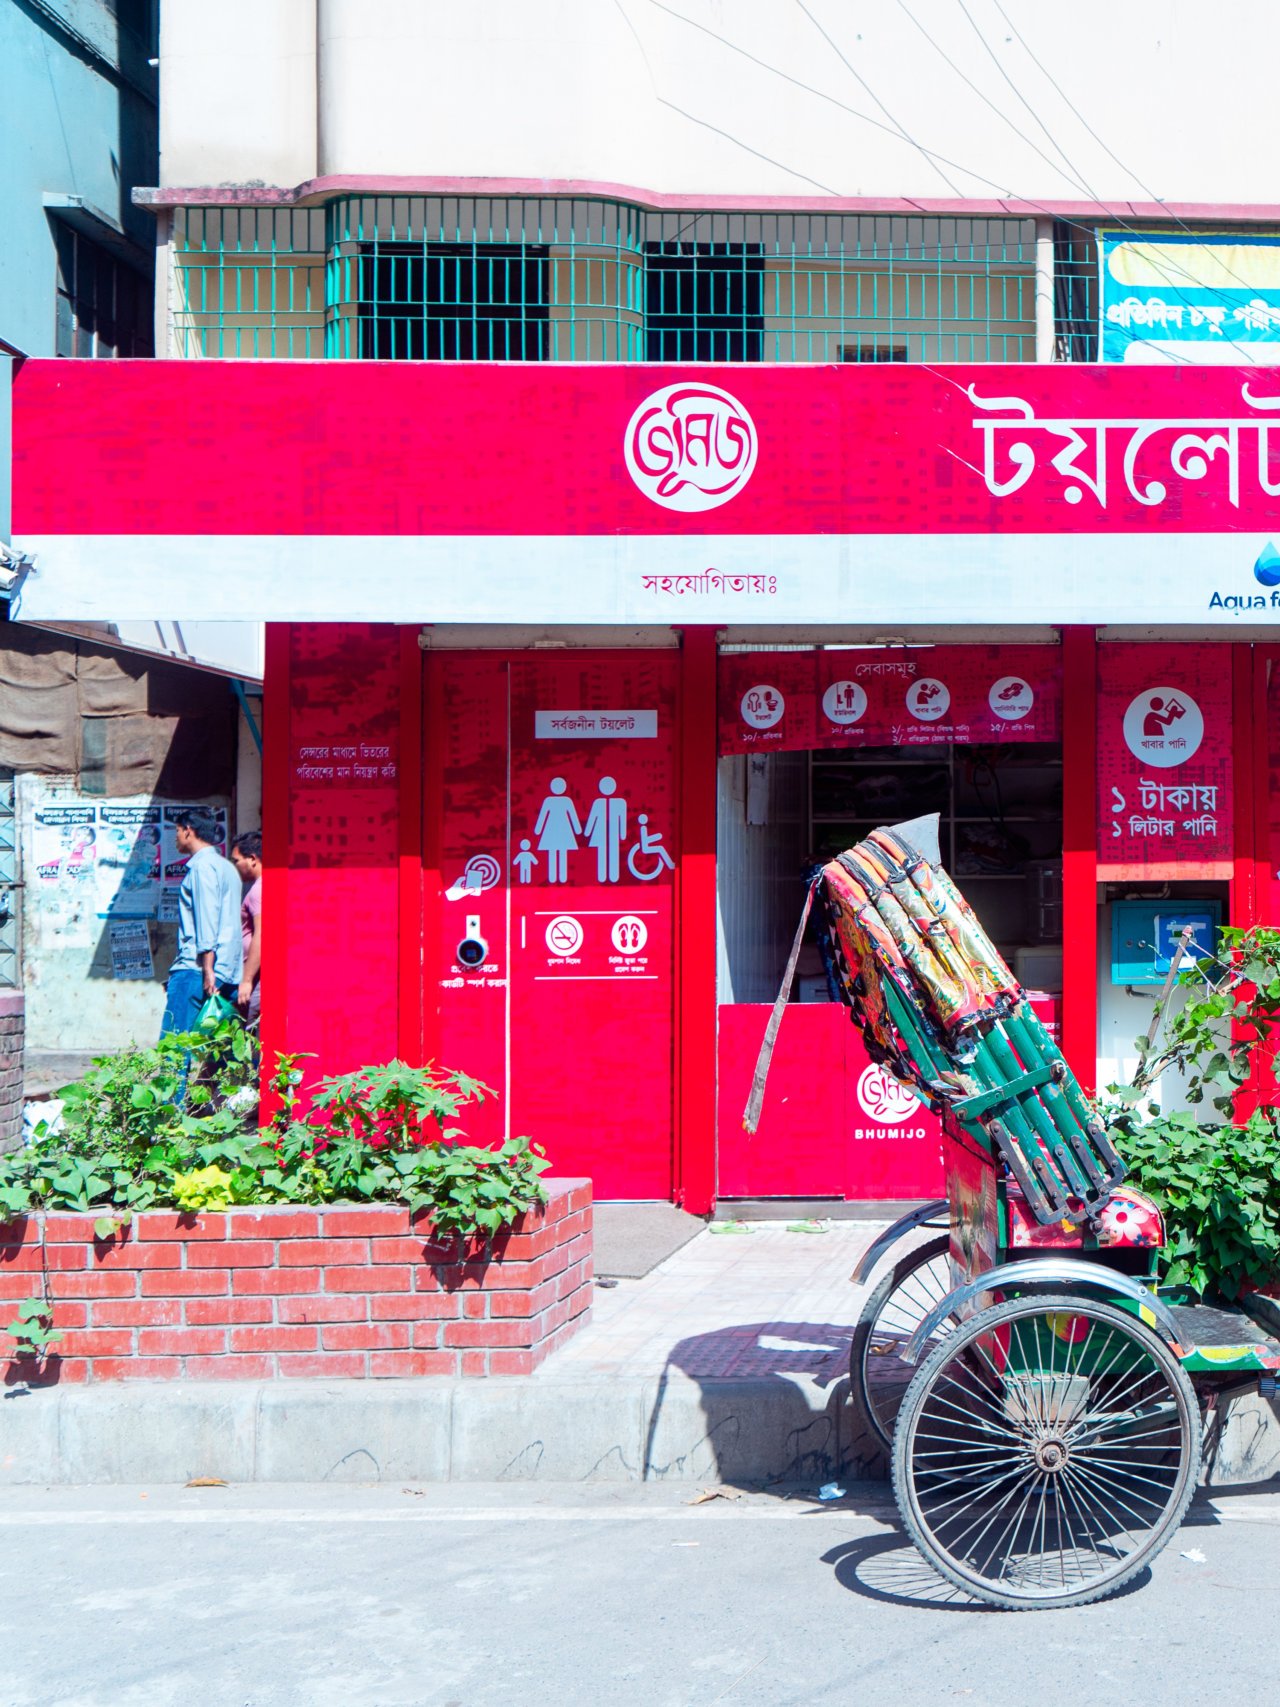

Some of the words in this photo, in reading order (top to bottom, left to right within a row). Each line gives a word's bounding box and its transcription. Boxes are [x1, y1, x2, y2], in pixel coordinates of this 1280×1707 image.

[641, 567, 777, 594] সহযোগিতায়ঃ
[1209, 591, 1267, 615] Aqua
[856, 661, 917, 677] সেবাসমূহ
[600, 716, 635, 730] টয়লেট
[1141, 740, 1164, 749] খাবার
[1168, 738, 1187, 749] পানি
[1111, 786, 1126, 813] ১
[1137, 777, 1218, 812] টাকায়
[1112, 821, 1122, 837] ১
[1128, 815, 1175, 837] লিটার
[1182, 814, 1218, 837] পানি
[855, 1129, 926, 1139] BHUMIJO
